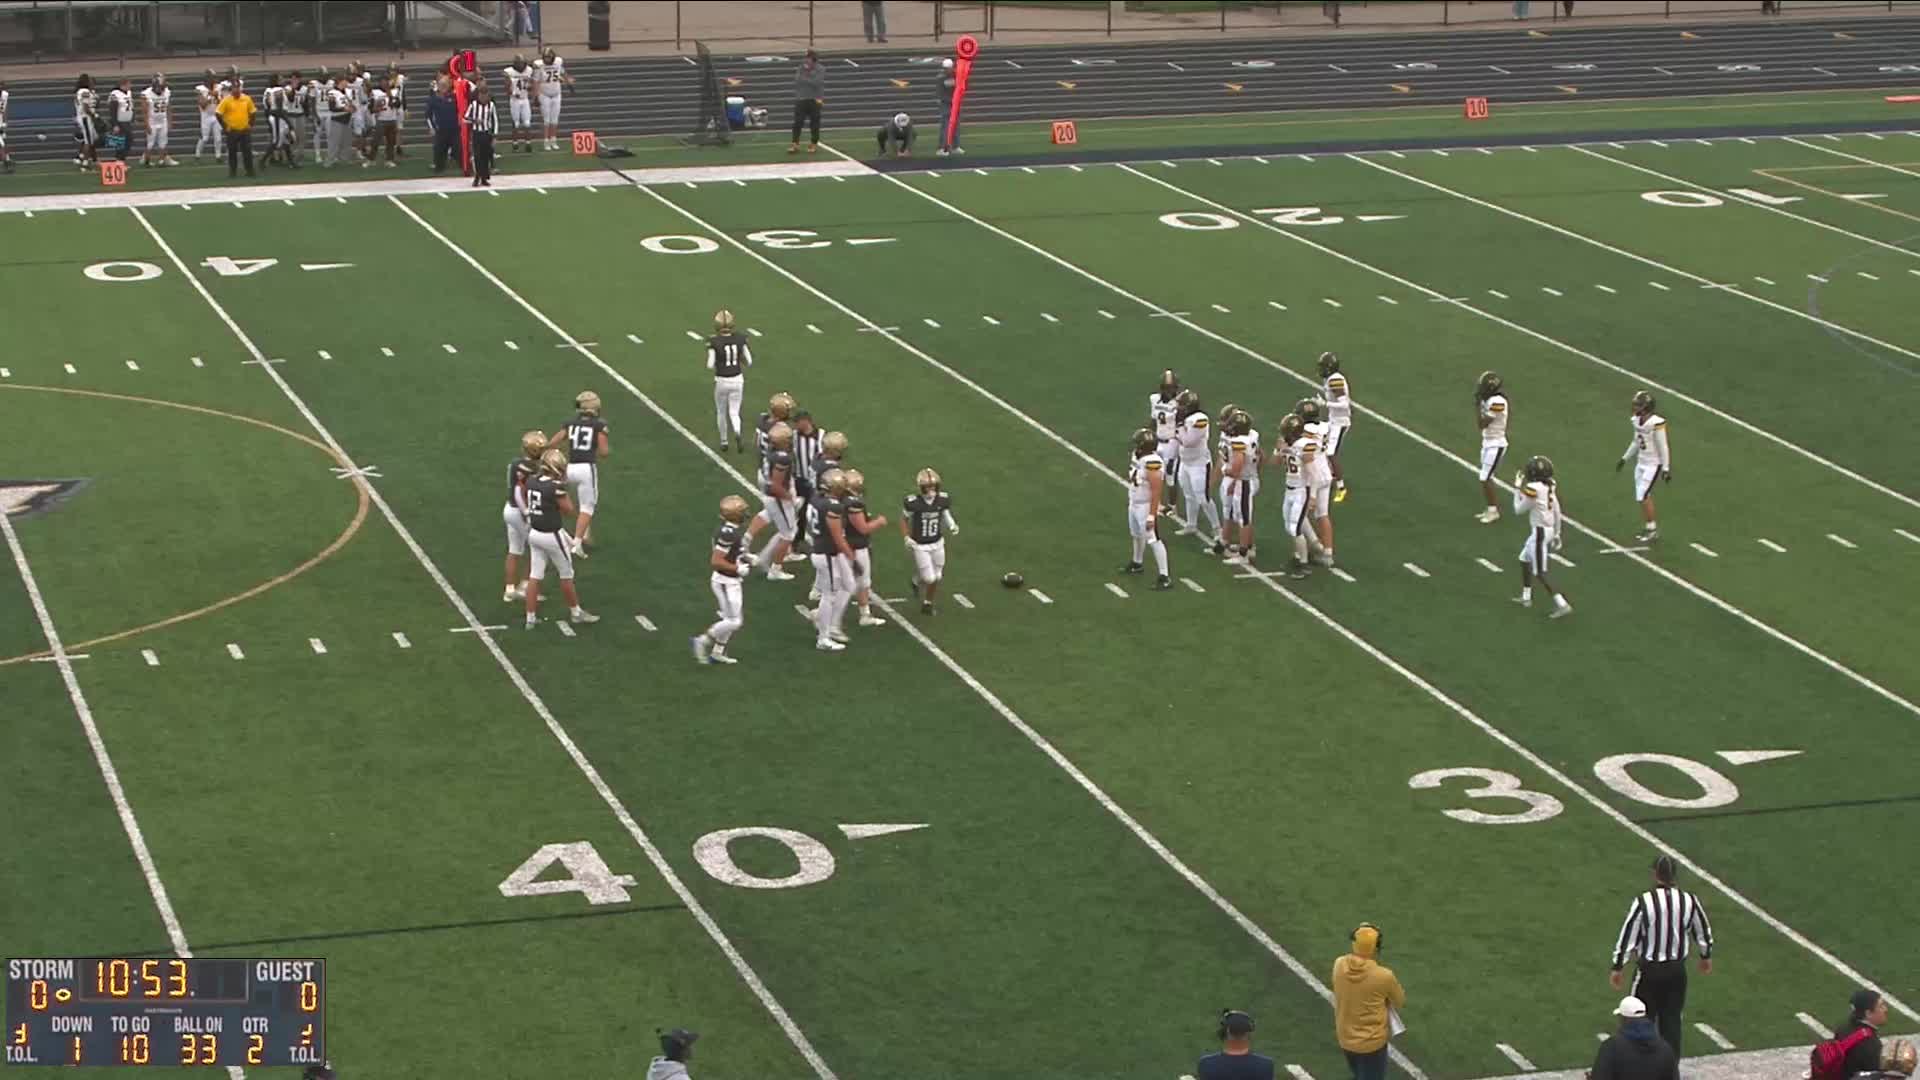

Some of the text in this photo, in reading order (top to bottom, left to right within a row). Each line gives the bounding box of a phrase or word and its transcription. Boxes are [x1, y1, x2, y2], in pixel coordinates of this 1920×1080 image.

[1471, 100, 1485, 116] 10
[1057, 124, 1073, 141] 20
[575, 135, 592, 152] 30
[104, 165, 123, 182] 40
[724, 344, 738, 366] 11
[568, 425, 593, 450] 43
